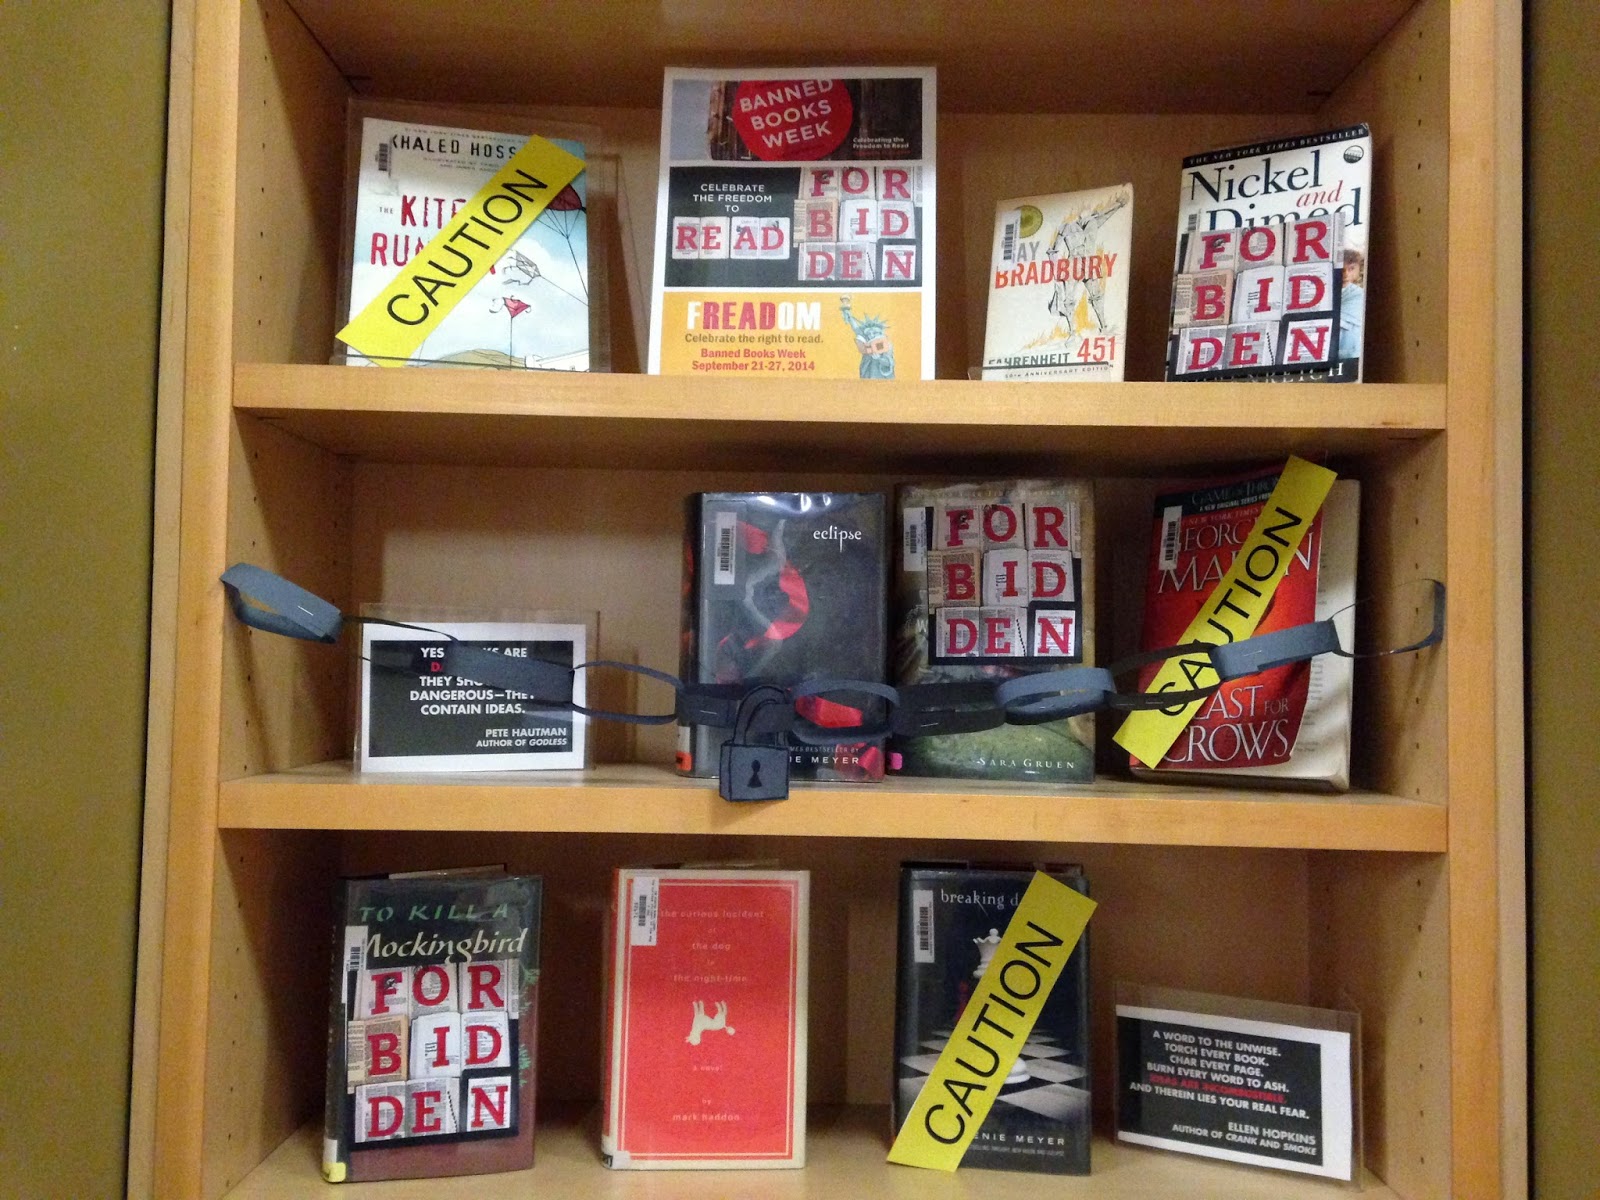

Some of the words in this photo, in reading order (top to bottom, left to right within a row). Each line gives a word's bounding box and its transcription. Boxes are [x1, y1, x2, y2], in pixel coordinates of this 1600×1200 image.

[739, 78, 834, 113] BANNED
[751, 99, 832, 130] BOOKS
[762, 121, 832, 148] WEEK
[1300, 128, 1365, 145] BESTSELLER
[471, 142, 518, 159] HOSS
[700, 183, 765, 193] CELEBRATE
[810, 167, 911, 199] FOR
[1189, 150, 1323, 203] Nickel
[693, 194, 715, 203] THE
[717, 194, 772, 203] FREEDOM
[1296, 180, 1344, 207] and
[380, 206, 394, 215] THE
[725, 204, 740, 213] TO
[809, 208, 909, 238] BID
[387, 169, 548, 326] CAUTION
[675, 226, 784, 251] READ
[1017, 241, 1040, 262] AY
[1199, 220, 1330, 269] FOR
[807, 251, 914, 279] DEN
[995, 253, 1118, 289] BRADBURY
[1193, 275, 1326, 321] BID
[687, 301, 821, 330] FREADOM
[685, 333, 736, 343] Celebrate
[738, 334, 755, 343] the
[758, 333, 782, 346] right
[784, 334, 795, 343] to
[797, 333, 824, 343] read.
[1077, 336, 1115, 362] 451
[1188, 326, 1329, 371] DEN
[692, 361, 748, 373] September
[751, 361, 786, 373] 21-27,
[788, 361, 815, 371] 2014
[701, 349, 741, 359] Banned
[743, 349, 775, 359] Books
[777, 349, 806, 359] Week
[1025, 368, 1078, 376] ANNIVERSARY
[1082, 364, 1114, 373] EDITION
[813, 525, 862, 553] eclipse
[947, 504, 1068, 547] FOR
[946, 561, 1066, 600] BID
[1157, 506, 1303, 716] CAUTION
[947, 618, 1073, 655] DEN
[421, 647, 444, 658] YES
[504, 648, 528, 657] ARE
[419, 676, 452, 686] THEY
[421, 704, 481, 715] CONTAIN
[486, 703, 526, 714] IDEAS.
[1193, 684, 1264, 720] AST
[1264, 698, 1290, 715] FOR
[476, 739, 513, 748] AUTHOR
[515, 739, 527, 747] OF
[529, 737, 567, 747] GODLESS
[485, 728, 509, 738] PETE
[512, 727, 567, 738] HAUTMAN
[977, 757, 1018, 767] SARA
[1023, 758, 1076, 769] GRUEN
[360, 905, 393, 922] TO
[408, 904, 477, 921] KILL
[492, 903, 508, 919] A
[941, 889, 1005, 911] breaking
[365, 928, 528, 964] Mockingbird
[692, 942, 708, 950] the
[712, 942, 731, 951] dog
[370, 964, 504, 1015] FOR
[924, 921, 1064, 1145] CAUTION
[1153, 1030, 1161, 1039] A
[1163, 1031, 1196, 1044] WORD
[1198, 1036, 1212, 1047] TO
[1215, 1038, 1233, 1050] THE
[1236, 1042, 1282, 1057] UNWISE.
[367, 1025, 502, 1076] BID
[1165, 1042, 1198, 1056] TORCH
[1201, 1048, 1231, 1061] EVERY
[1234, 1053, 1269, 1067] BOOK.
[1147, 1062, 1175, 1075] BURN
[1177, 1067, 1207, 1080] EVERY
[1210, 1072, 1244, 1086] WORD
[1246, 1078, 1261, 1089] TO
[1264, 1081, 1290, 1094] ASH.
[1169, 1055, 1197, 1067] CHAR
[1200, 1059, 1231, 1072] EVERY
[1233, 1064, 1264, 1078] PAGE.
[367, 1085, 508, 1138] DEN
[1130, 1082, 1152, 1093] AND
[1154, 1086, 1195, 1101] THEREIN
[1197, 1093, 1217, 1105] LIES
[1219, 1097, 1250, 1110] YOUR
[1252, 1102, 1278, 1114] REAL
[1280, 1107, 1310, 1120] FEAR.
[672, 1113, 697, 1121] mark
[701, 1112, 740, 1121] haddon
[1015, 1135, 1065, 1146] MEYER
[1172, 1124, 1209, 1138] AUTHOR
[1211, 1130, 1223, 1140] OF
[1225, 1132, 1258, 1146] CRANK
[1259, 1138, 1280, 1149] AND
[1283, 1142, 1317, 1156] SMOKE
[1228, 1121, 1259, 1136] ELLEN
[1262, 1127, 1316, 1146] HOPKINS
